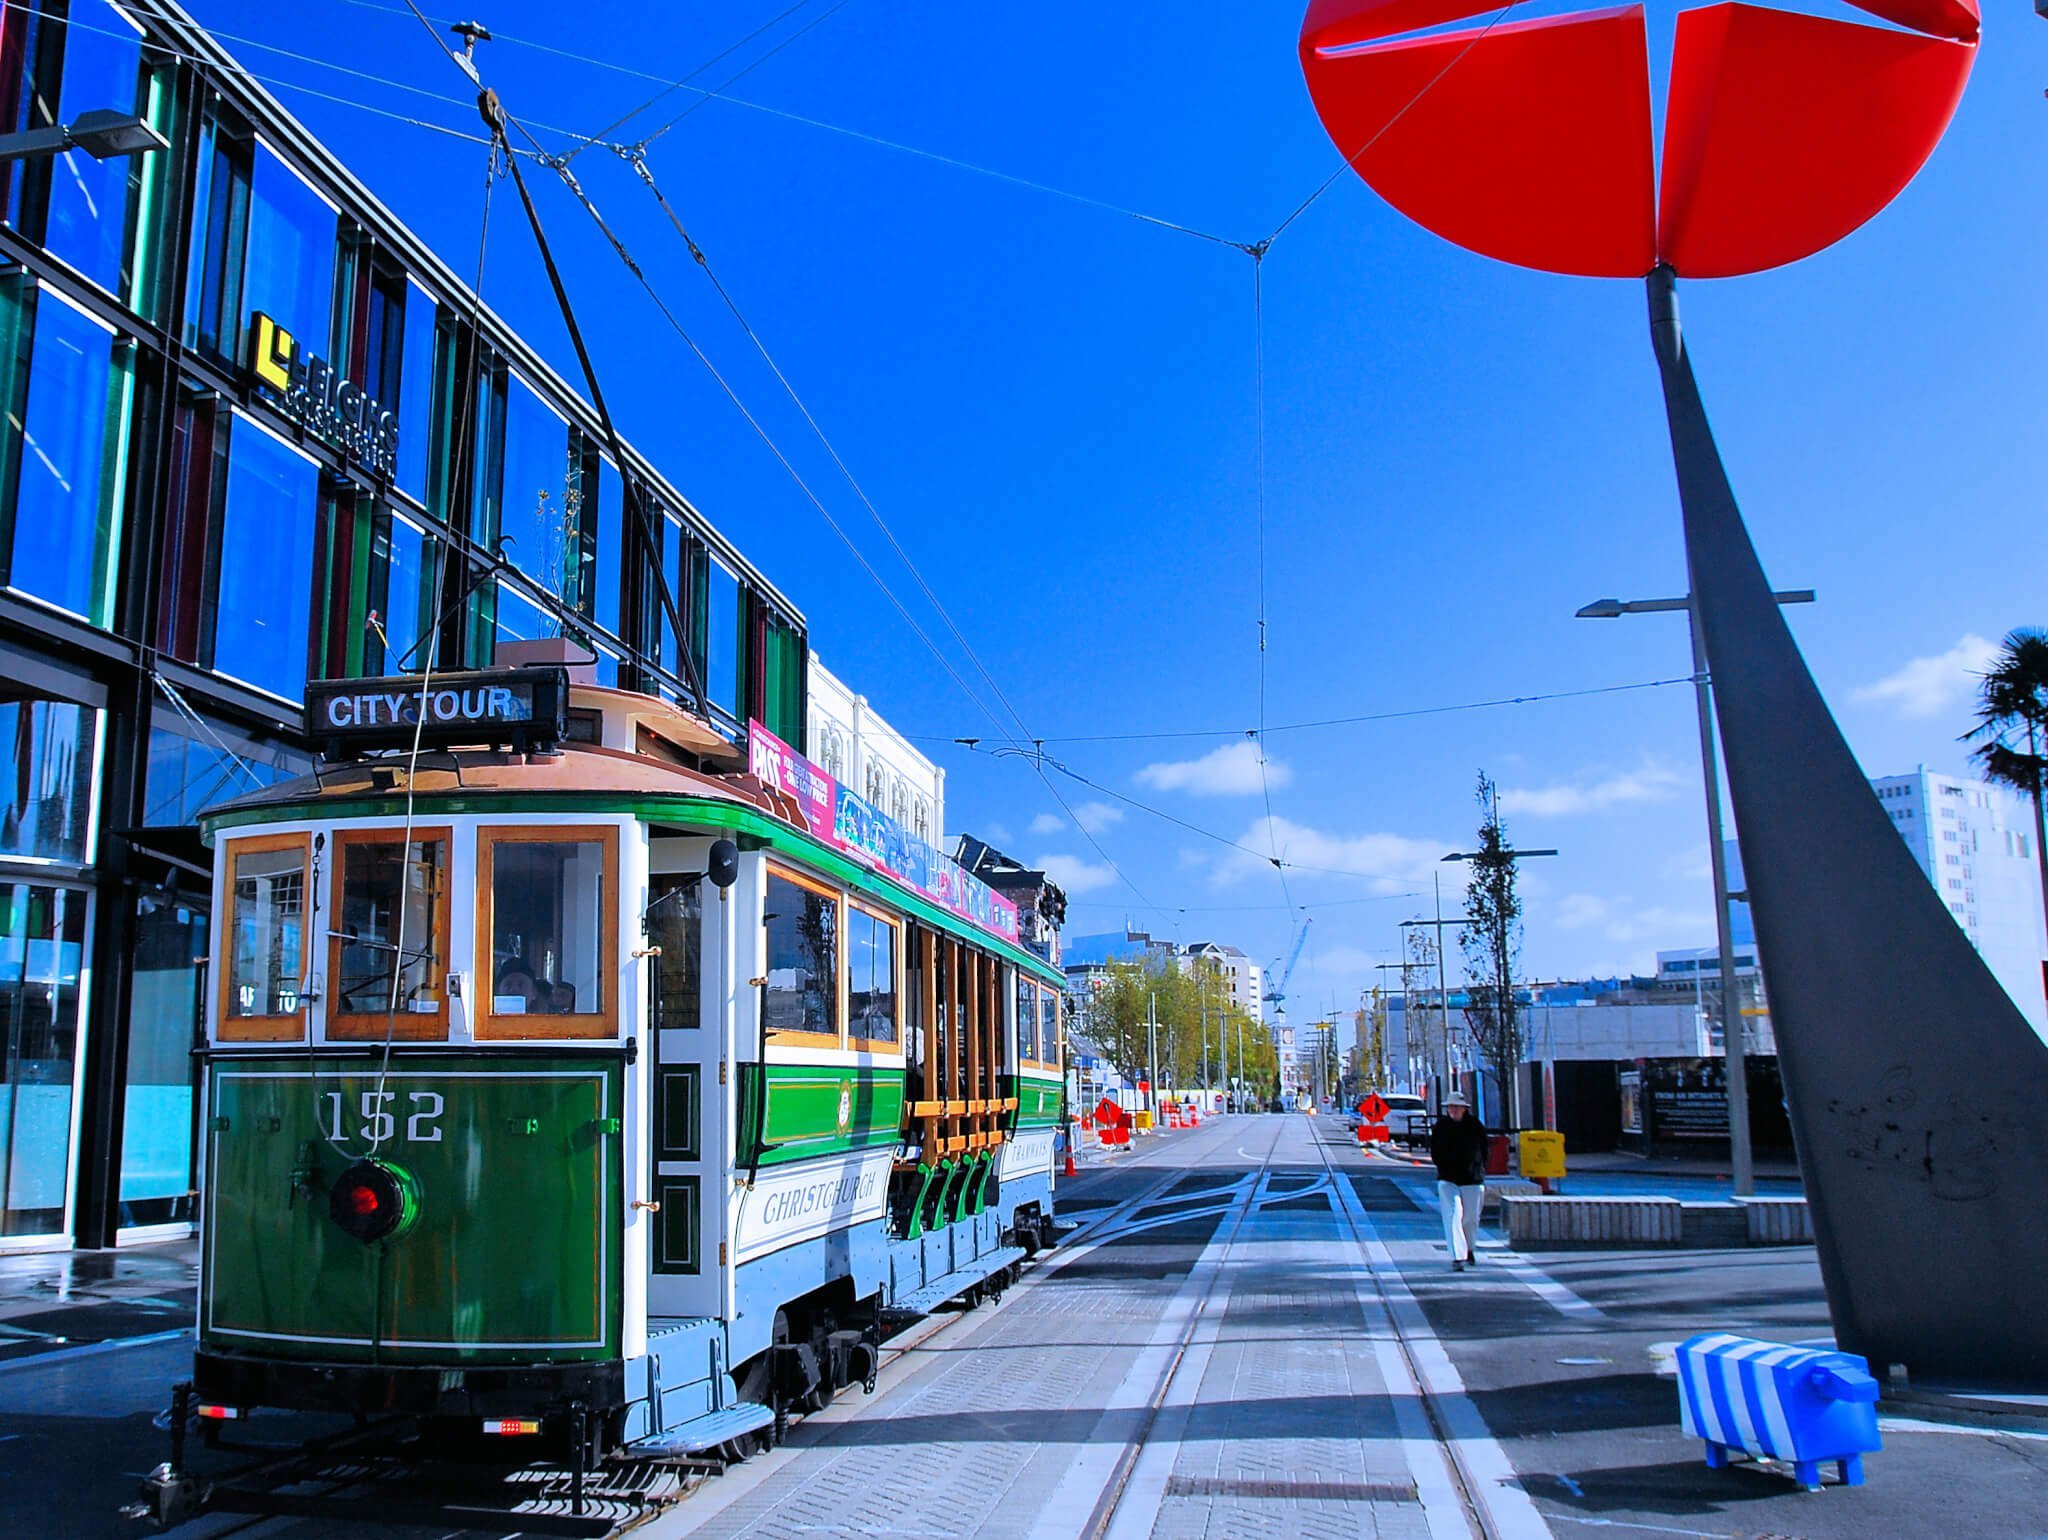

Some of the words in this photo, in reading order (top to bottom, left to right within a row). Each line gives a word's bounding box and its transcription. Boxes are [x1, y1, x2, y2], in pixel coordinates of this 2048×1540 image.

[328, 693, 406, 727] CITY
[412, 687, 512, 722] TOUR
[325, 1092, 444, 1142] 152
[763, 1171, 877, 1225] CHRISTCHURCH
